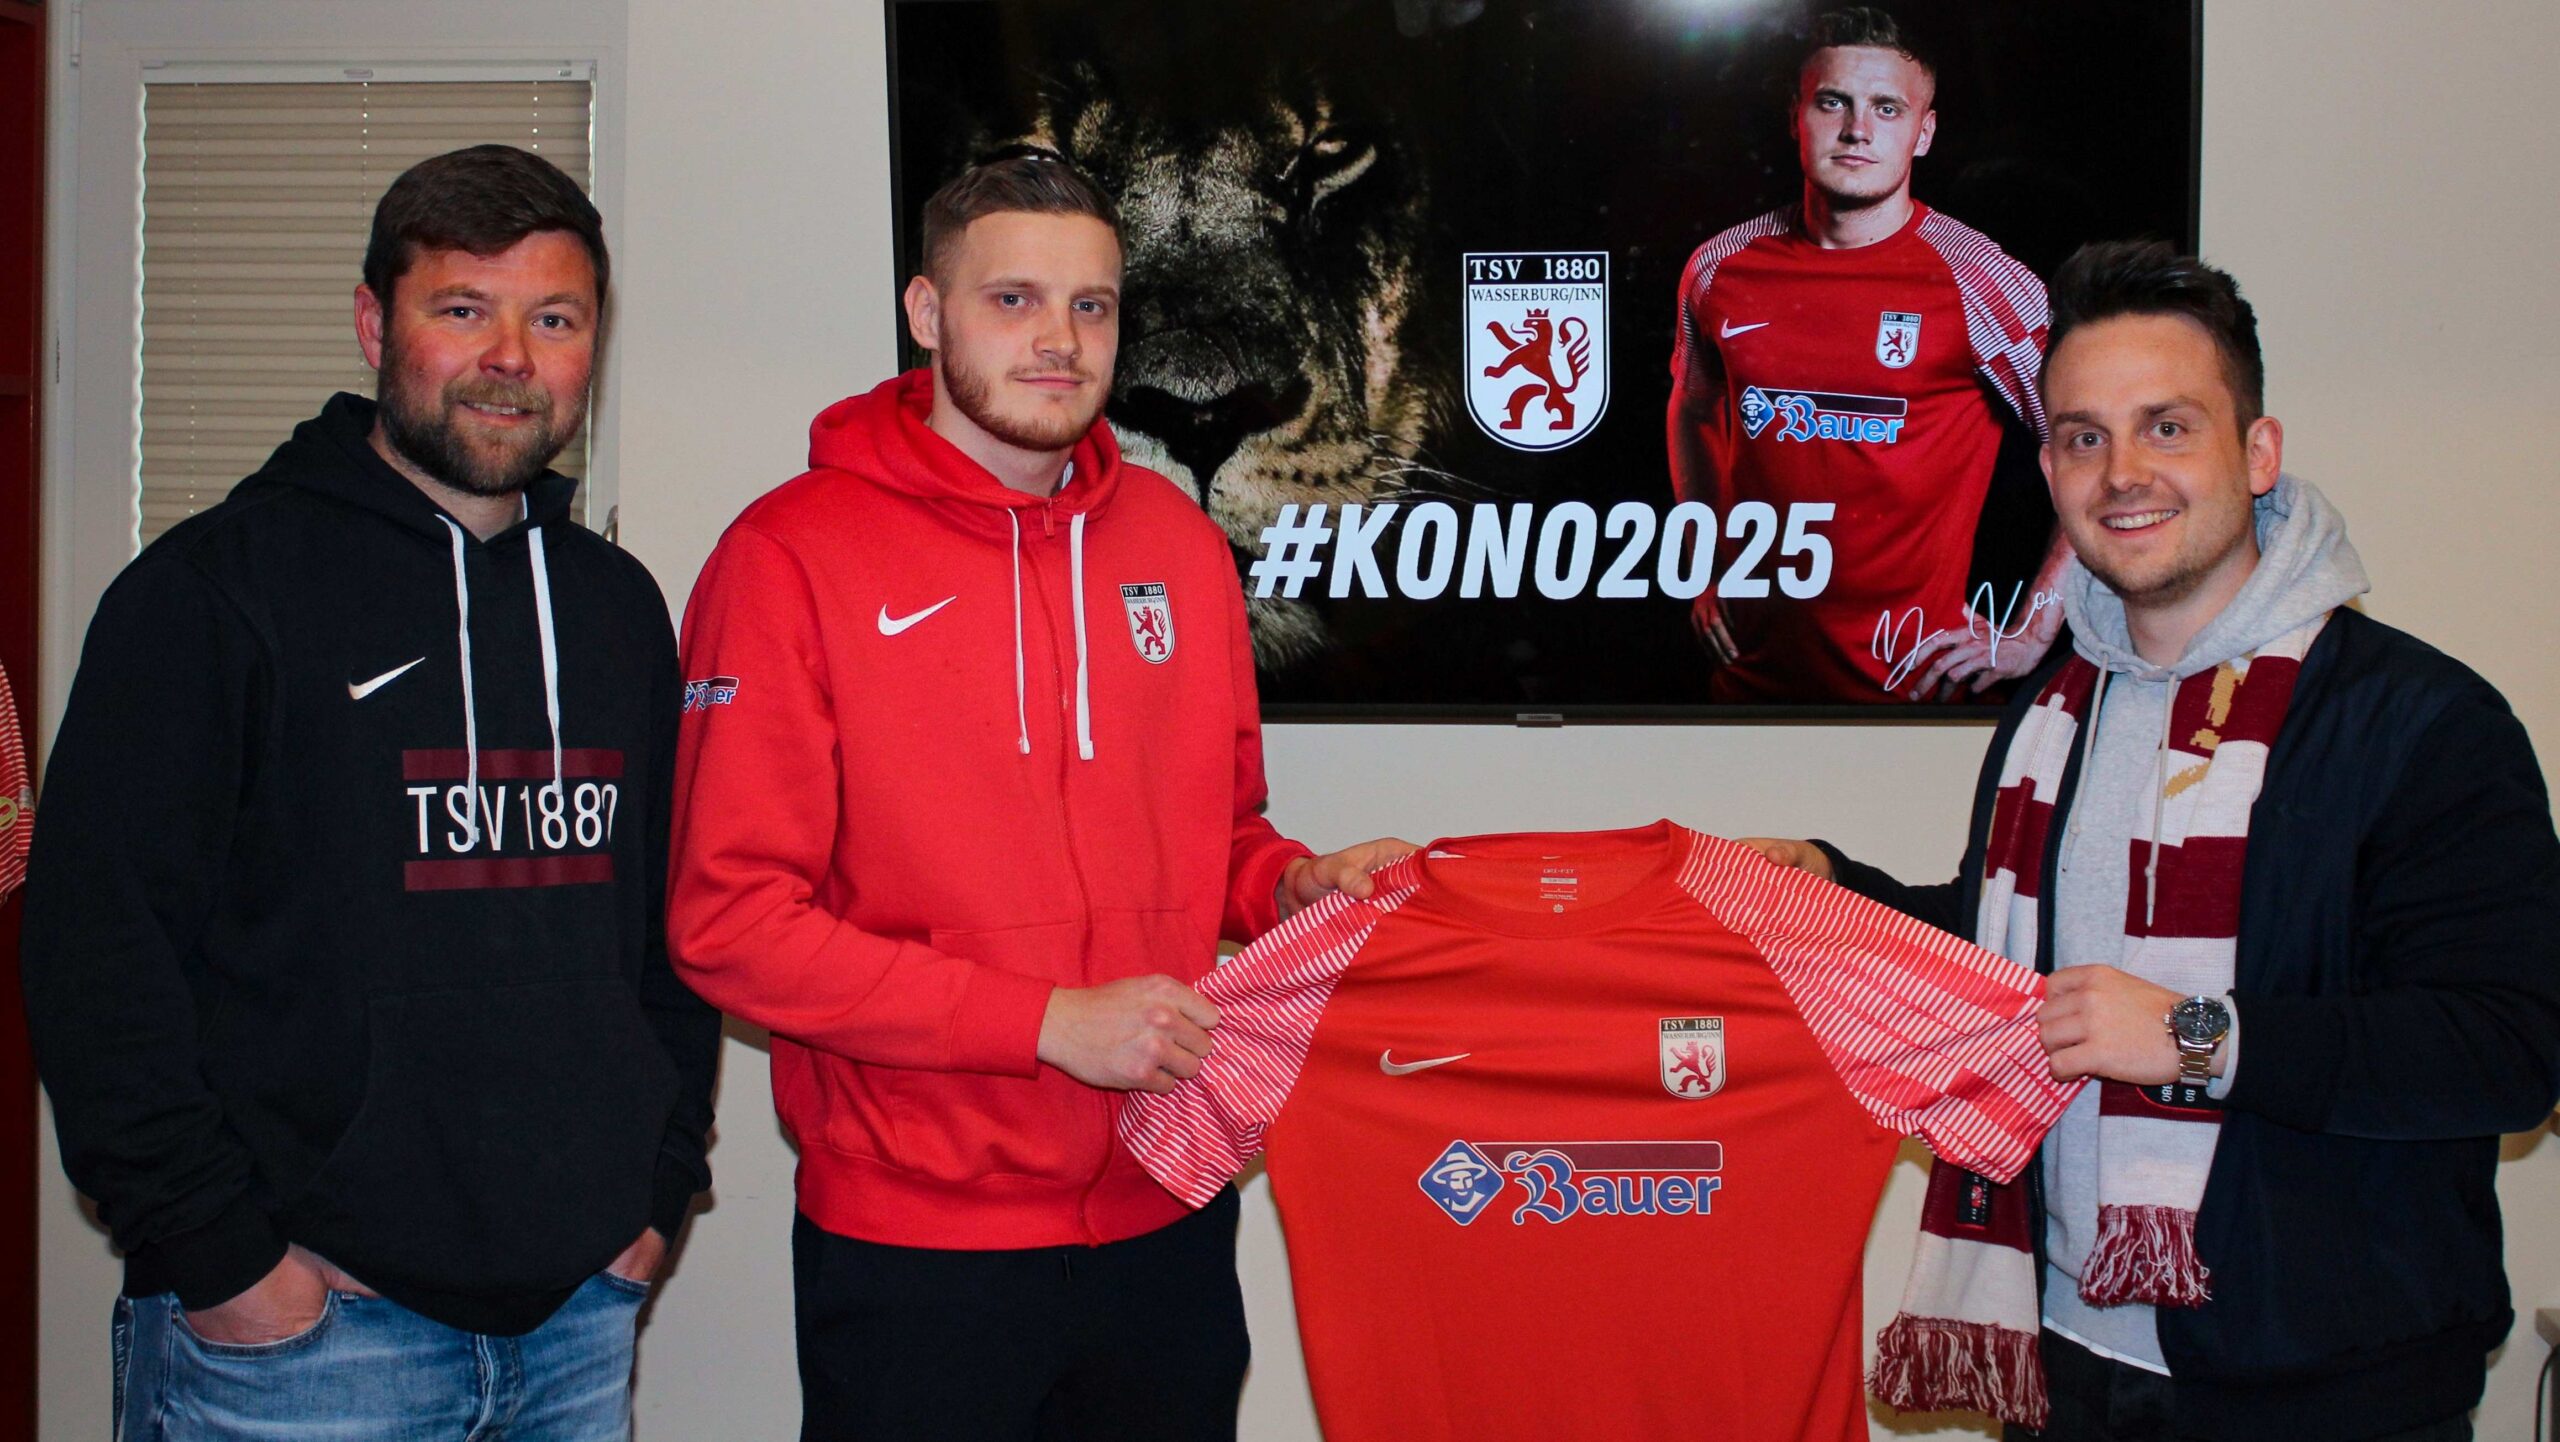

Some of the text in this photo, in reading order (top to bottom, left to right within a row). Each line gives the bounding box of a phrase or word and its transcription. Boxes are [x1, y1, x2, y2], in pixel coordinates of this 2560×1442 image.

[1470, 258, 1600, 280] TSV 1880
[1472, 287, 1602, 303] WASSERBURG/INN
[1775, 394, 1904, 444] Bauer
[1249, 501, 1836, 600] #KONO2025
[1123, 585, 1163, 596] TSV 1880
[407, 784, 506, 853] TSV
[1662, 1018, 1719, 1030] TSV 1880
[1504, 1149, 1722, 1225] Bauer
